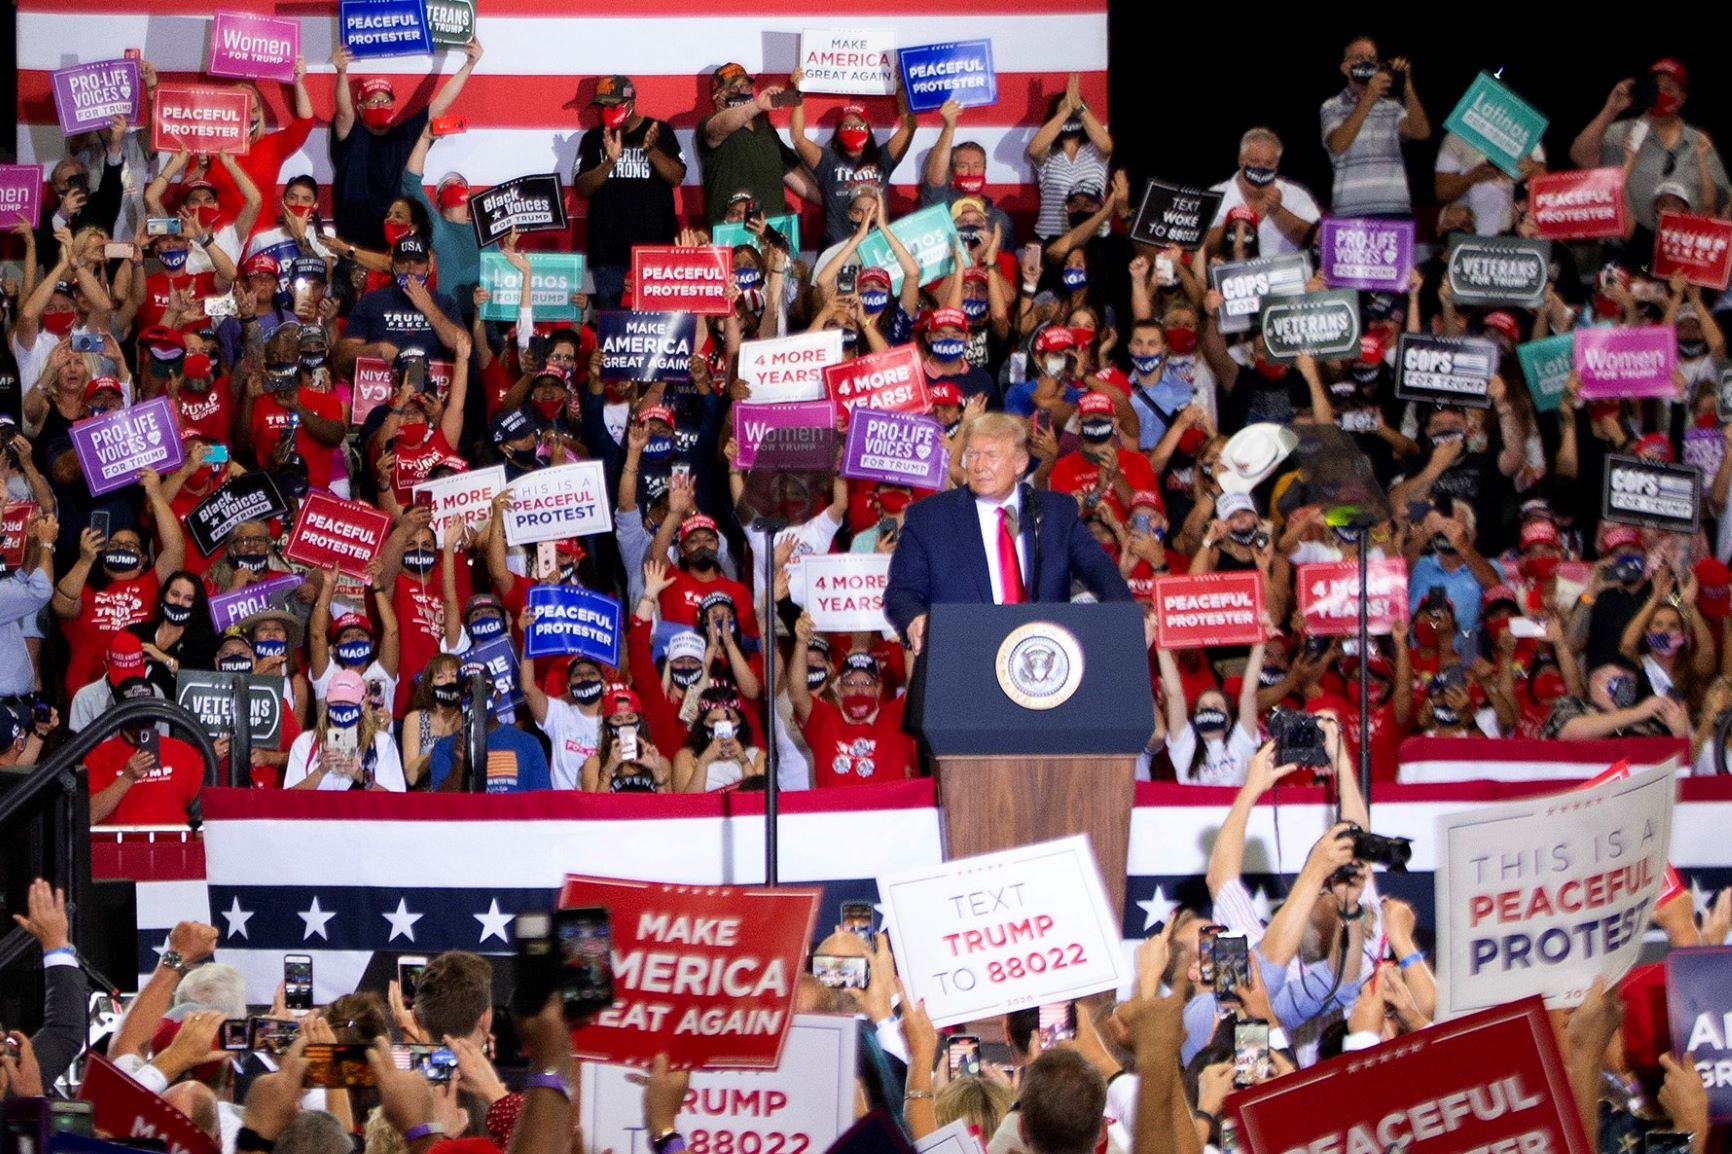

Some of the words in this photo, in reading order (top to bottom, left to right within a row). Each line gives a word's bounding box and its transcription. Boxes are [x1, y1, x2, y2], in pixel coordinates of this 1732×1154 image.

[347, 14, 419, 30] PEACEFUL
[426, 5, 469, 26] TERANS
[348, 31, 420, 45] PROTESTER
[435, 22, 463, 34] TRUMP
[223, 29, 291, 57] Women
[831, 40, 868, 50] MAKE
[228, 51, 247, 61] FOR
[251, 53, 283, 64] TRUMP
[807, 52, 891, 67] AMERICA
[805, 69, 847, 80] GREAT
[852, 71, 891, 81] AGAIN
[909, 58, 984, 79] PEACEFUL
[69, 68, 129, 94] PRO-LIFE
[913, 74, 985, 94] PROTESTER
[73, 87, 120, 108] VOICES
[78, 108, 98, 120] FOR
[162, 106, 241, 122] PEACEFUL
[162, 124, 239, 138] PROTESTER
[483, 189, 519, 213] Black
[505, 198, 549, 215] Voices
[1173, 197, 1200, 212] TEXT
[493, 218, 512, 232] FOR
[515, 213, 550, 223] TRUMP
[1163, 211, 1199, 227] WOKE
[1149, 222, 1165, 238] TO
[401, 240, 422, 252] USA
[642, 267, 724, 280] PEACEFUL
[1461, 256, 1538, 280] VETERANS
[494, 268, 568, 289] Lanos
[1221, 274, 1270, 300] COPS
[643, 285, 724, 297] PROTESTER
[384, 313, 424, 322] TRUM
[1272, 312, 1348, 335] VETERANS
[626, 323, 665, 335] MAKE
[603, 336, 689, 355] AMERICA
[933, 343, 963, 355] MAGA
[603, 357, 643, 369] GREAT
[648, 356, 689, 371] AGAIN
[755, 355, 765, 366] 4
[772, 349, 826, 365] MORE
[1404, 349, 1453, 373] COPS
[1584, 348, 1664, 371] Women
[838, 380, 851, 395] 4
[854, 366, 910, 393] MORE
[90, 412, 159, 448] PRO-LIFE
[744, 422, 824, 444] Women
[866, 420, 935, 445] PRO-LIFE
[96, 436, 147, 464] VOICES
[778, 441, 817, 451] TRUMP
[865, 438, 913, 459] VOICES
[104, 462, 126, 477] FOR
[129, 449, 167, 468] TRUMP
[863, 457, 885, 468] FOR
[889, 459, 928, 473] TRUMP
[558, 480, 572, 491] IS
[582, 478, 591, 487] A
[199, 490, 234, 522] Black
[221, 491, 266, 521] Voices
[444, 487, 492, 510] MORE
[513, 491, 593, 512] PEACEFUL
[235, 505, 269, 525] TRUMP
[516, 506, 596, 528] PROTEST
[306, 513, 376, 545] PEACEFUL
[301, 530, 371, 561] PROTESTER
[106, 554, 137, 566] TRUMP
[404, 555, 435, 565] TRUMP
[815, 576, 827, 589] 4
[833, 576, 886, 589] MORE
[1164, 590, 1254, 610] PEACEFUL
[164, 605, 190, 621] TRUMP
[534, 604, 613, 630] PEACEFUL
[1165, 611, 1254, 629] PROTESTER
[472, 620, 501, 635] MAGA
[536, 624, 612, 647] PROTESTER
[338, 646, 370, 659] MAGA
[221, 662, 251, 671] TRUMP
[672, 668, 701, 685] TRUMP
[807, 668, 826, 682] UMP
[571, 683, 601, 698] TRUMP
[193, 696, 270, 717] VETENS
[329, 708, 359, 722] MAGA
[200, 715, 220, 724] FOR
[1469, 843, 1570, 885] THIS
[1593, 831, 1622, 859] IS
[1642, 819, 1654, 841] A
[948, 882, 1026, 920] TEXT
[1469, 857, 1653, 928] PEACEFUL
[636, 912, 743, 947] MAKE
[942, 914, 1054, 958] TRUMP
[1470, 898, 1648, 977] PROTEST
[610, 950, 787, 998] MERICA
[931, 968, 976, 996] TO
[986, 942, 1088, 985] 88022
[673, 1008, 784, 1036] AGAIN
[679, 1088, 788, 1118] RUMP
